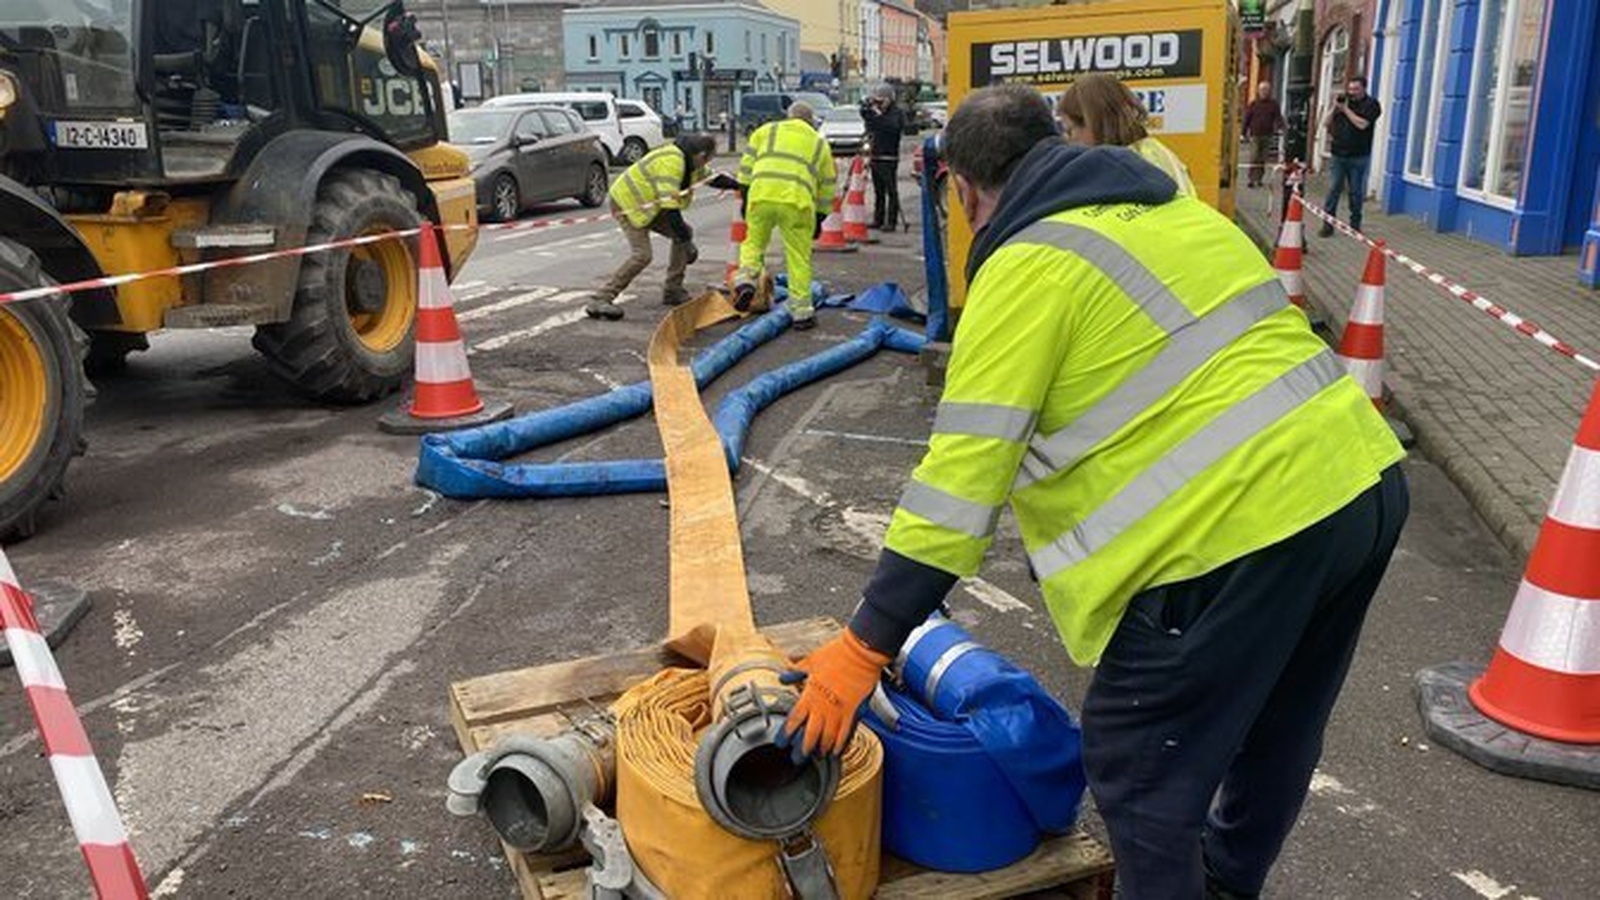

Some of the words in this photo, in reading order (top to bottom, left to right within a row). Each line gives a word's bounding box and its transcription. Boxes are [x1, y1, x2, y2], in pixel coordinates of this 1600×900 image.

[990, 32, 1180, 75] SELWOOD
[1003, 67, 1165, 84] www.selwops.com
[66, 127, 137, 146] 12-C-14340
